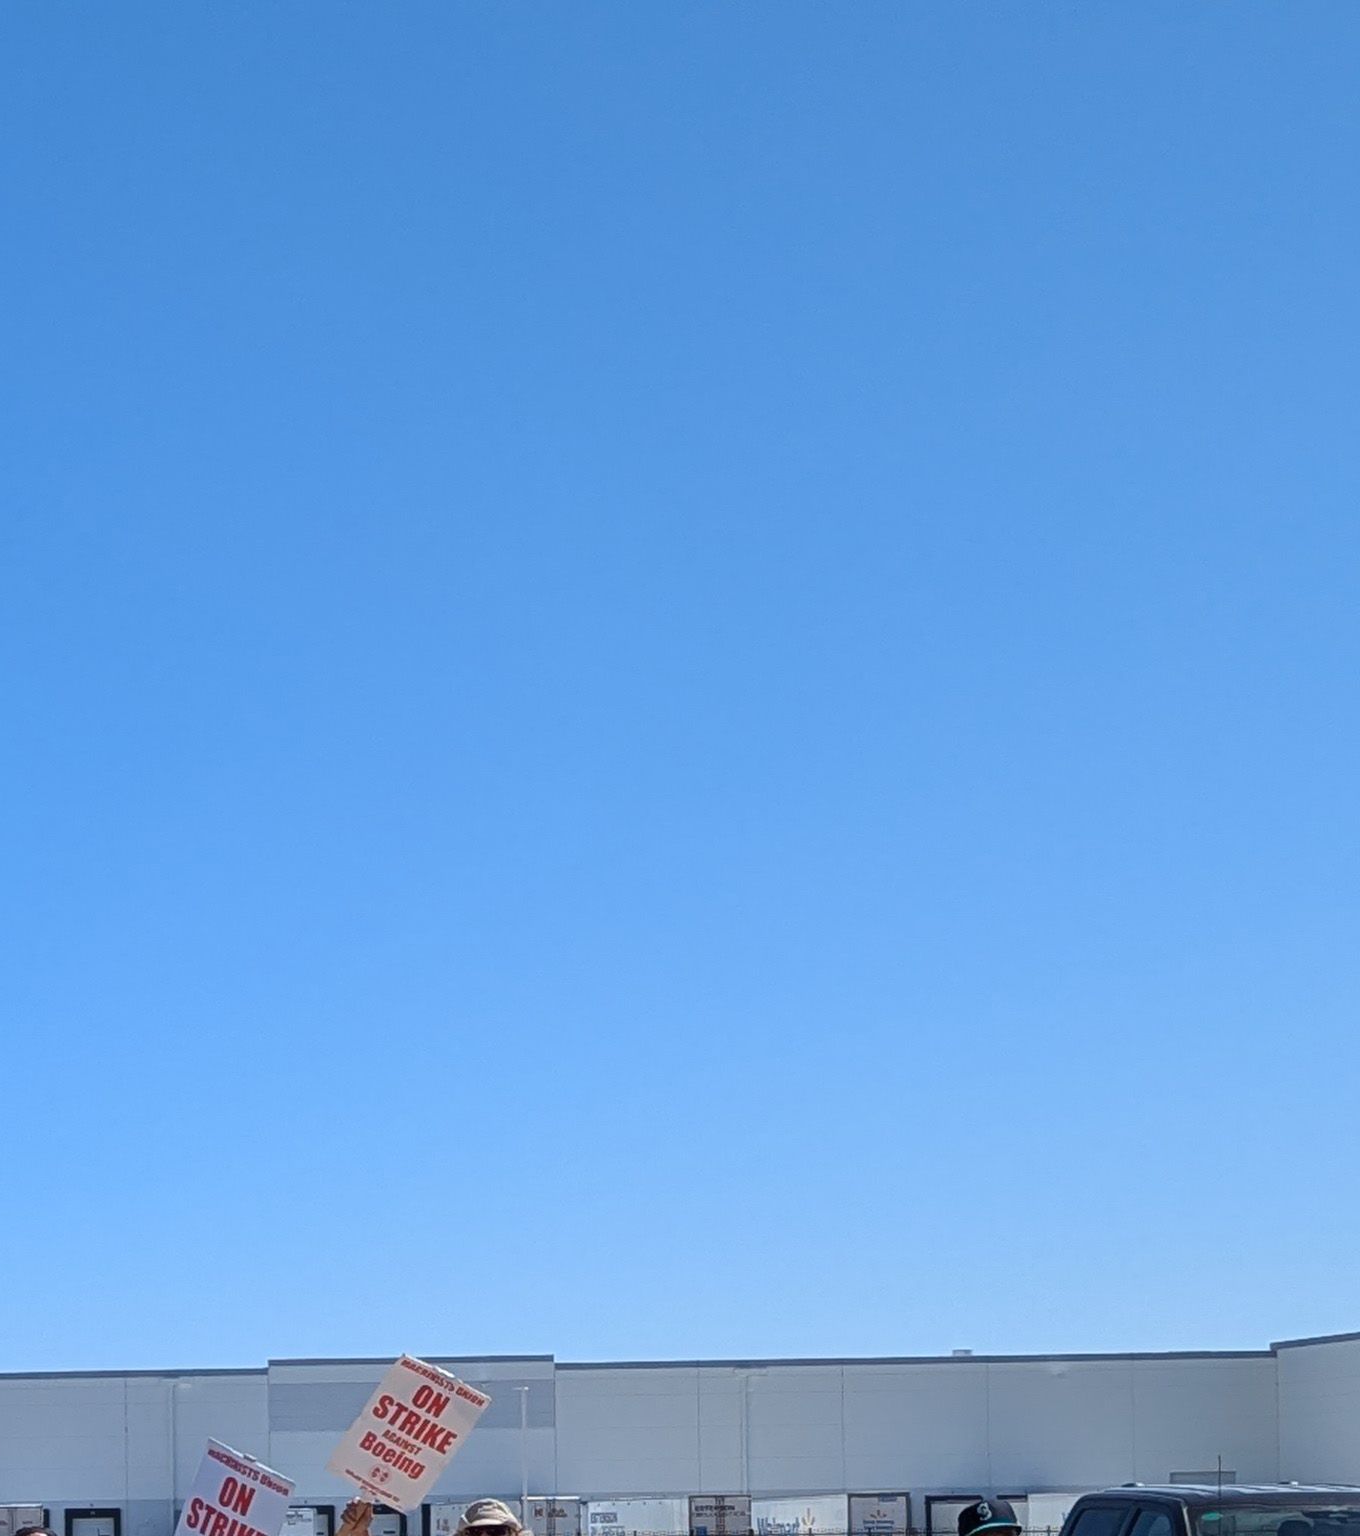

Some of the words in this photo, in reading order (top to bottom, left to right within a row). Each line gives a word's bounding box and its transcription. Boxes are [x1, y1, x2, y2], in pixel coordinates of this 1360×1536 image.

[411, 1384, 450, 1418] ON
[372, 1394, 458, 1455] STRIKE
[382, 1429, 423, 1456] AGAINST
[359, 1430, 426, 1479] Boeing
[218, 1476, 256, 1516] ON
